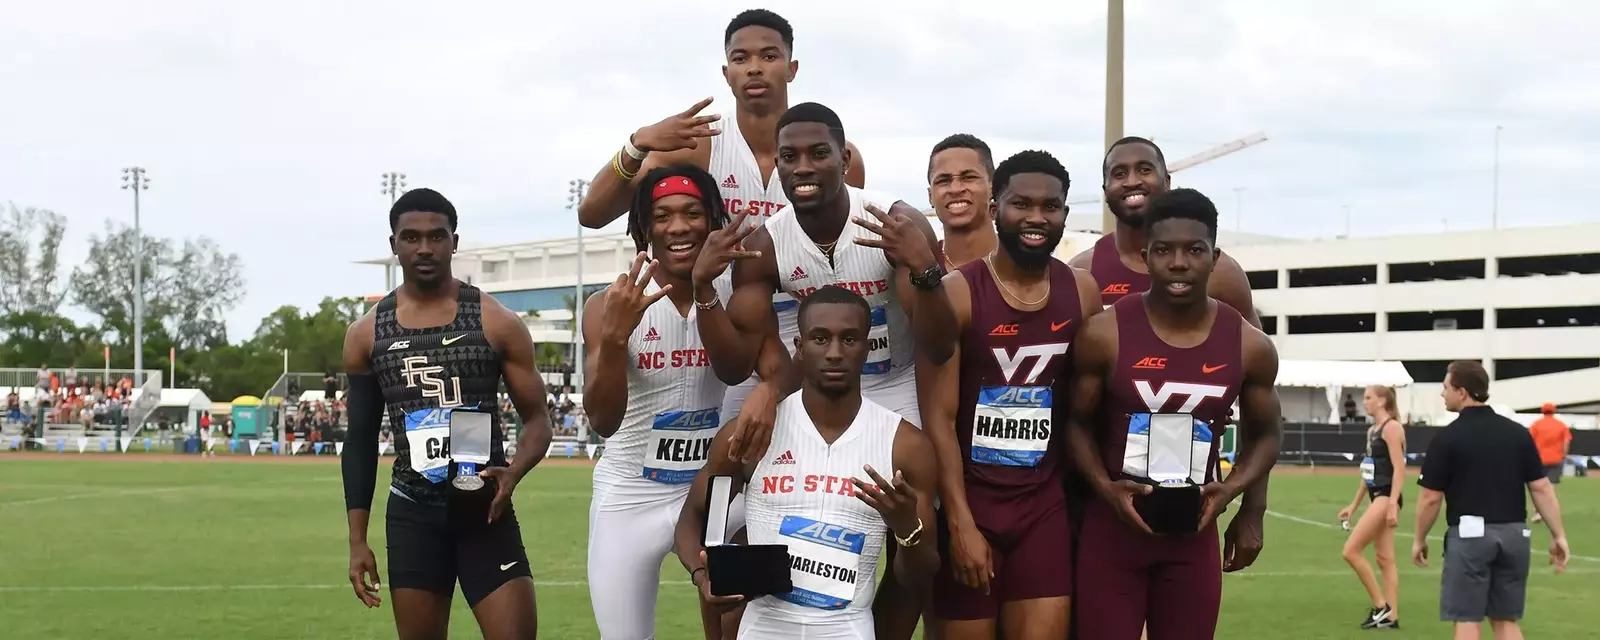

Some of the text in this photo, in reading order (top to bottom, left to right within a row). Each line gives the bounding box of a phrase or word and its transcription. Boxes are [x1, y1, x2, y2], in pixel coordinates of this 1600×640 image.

[1103, 284, 1130, 292] ACC
[992, 324, 1019, 333] ACC
[388, 340, 410, 350] ACC
[637, 349, 710, 369] NC STA
[991, 342, 1070, 385] VT
[1135, 357, 1168, 367] ACC
[400, 356, 464, 408] FSU
[995, 386, 1046, 403] ACC
[1133, 380, 1230, 412] VT
[420, 409, 451, 425] AC
[669, 410, 716, 426] ACC
[976, 415, 1050, 440] HARRIS
[425, 436, 451, 460] GA
[656, 437, 713, 462] KELLY
[762, 476, 794, 494] NC
[797, 522, 861, 546] ACC
